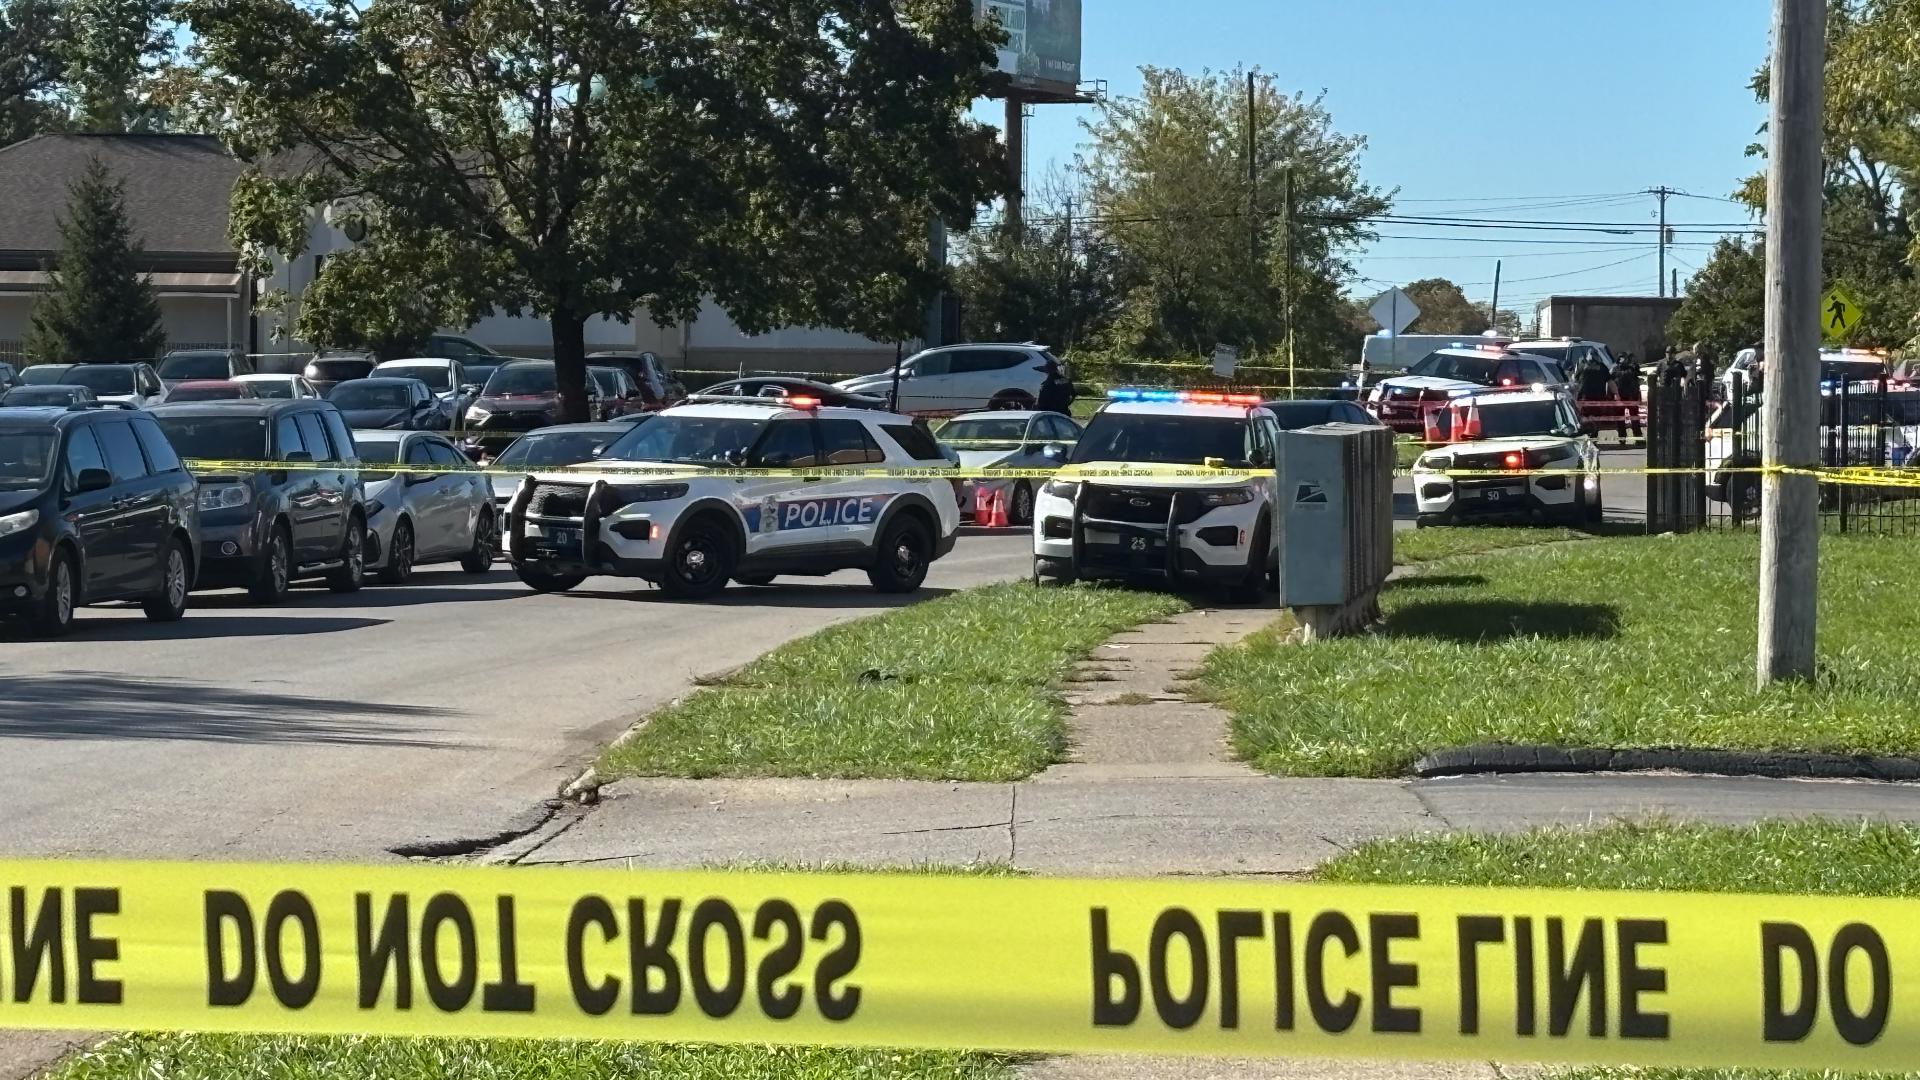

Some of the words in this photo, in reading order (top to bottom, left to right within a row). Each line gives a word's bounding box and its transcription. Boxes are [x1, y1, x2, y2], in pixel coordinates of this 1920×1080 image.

[1487, 490, 1500, 502] 50
[784, 496, 873, 528] POLICE
[556, 531, 568, 545] 20
[1130, 536, 1146, 551] 25
